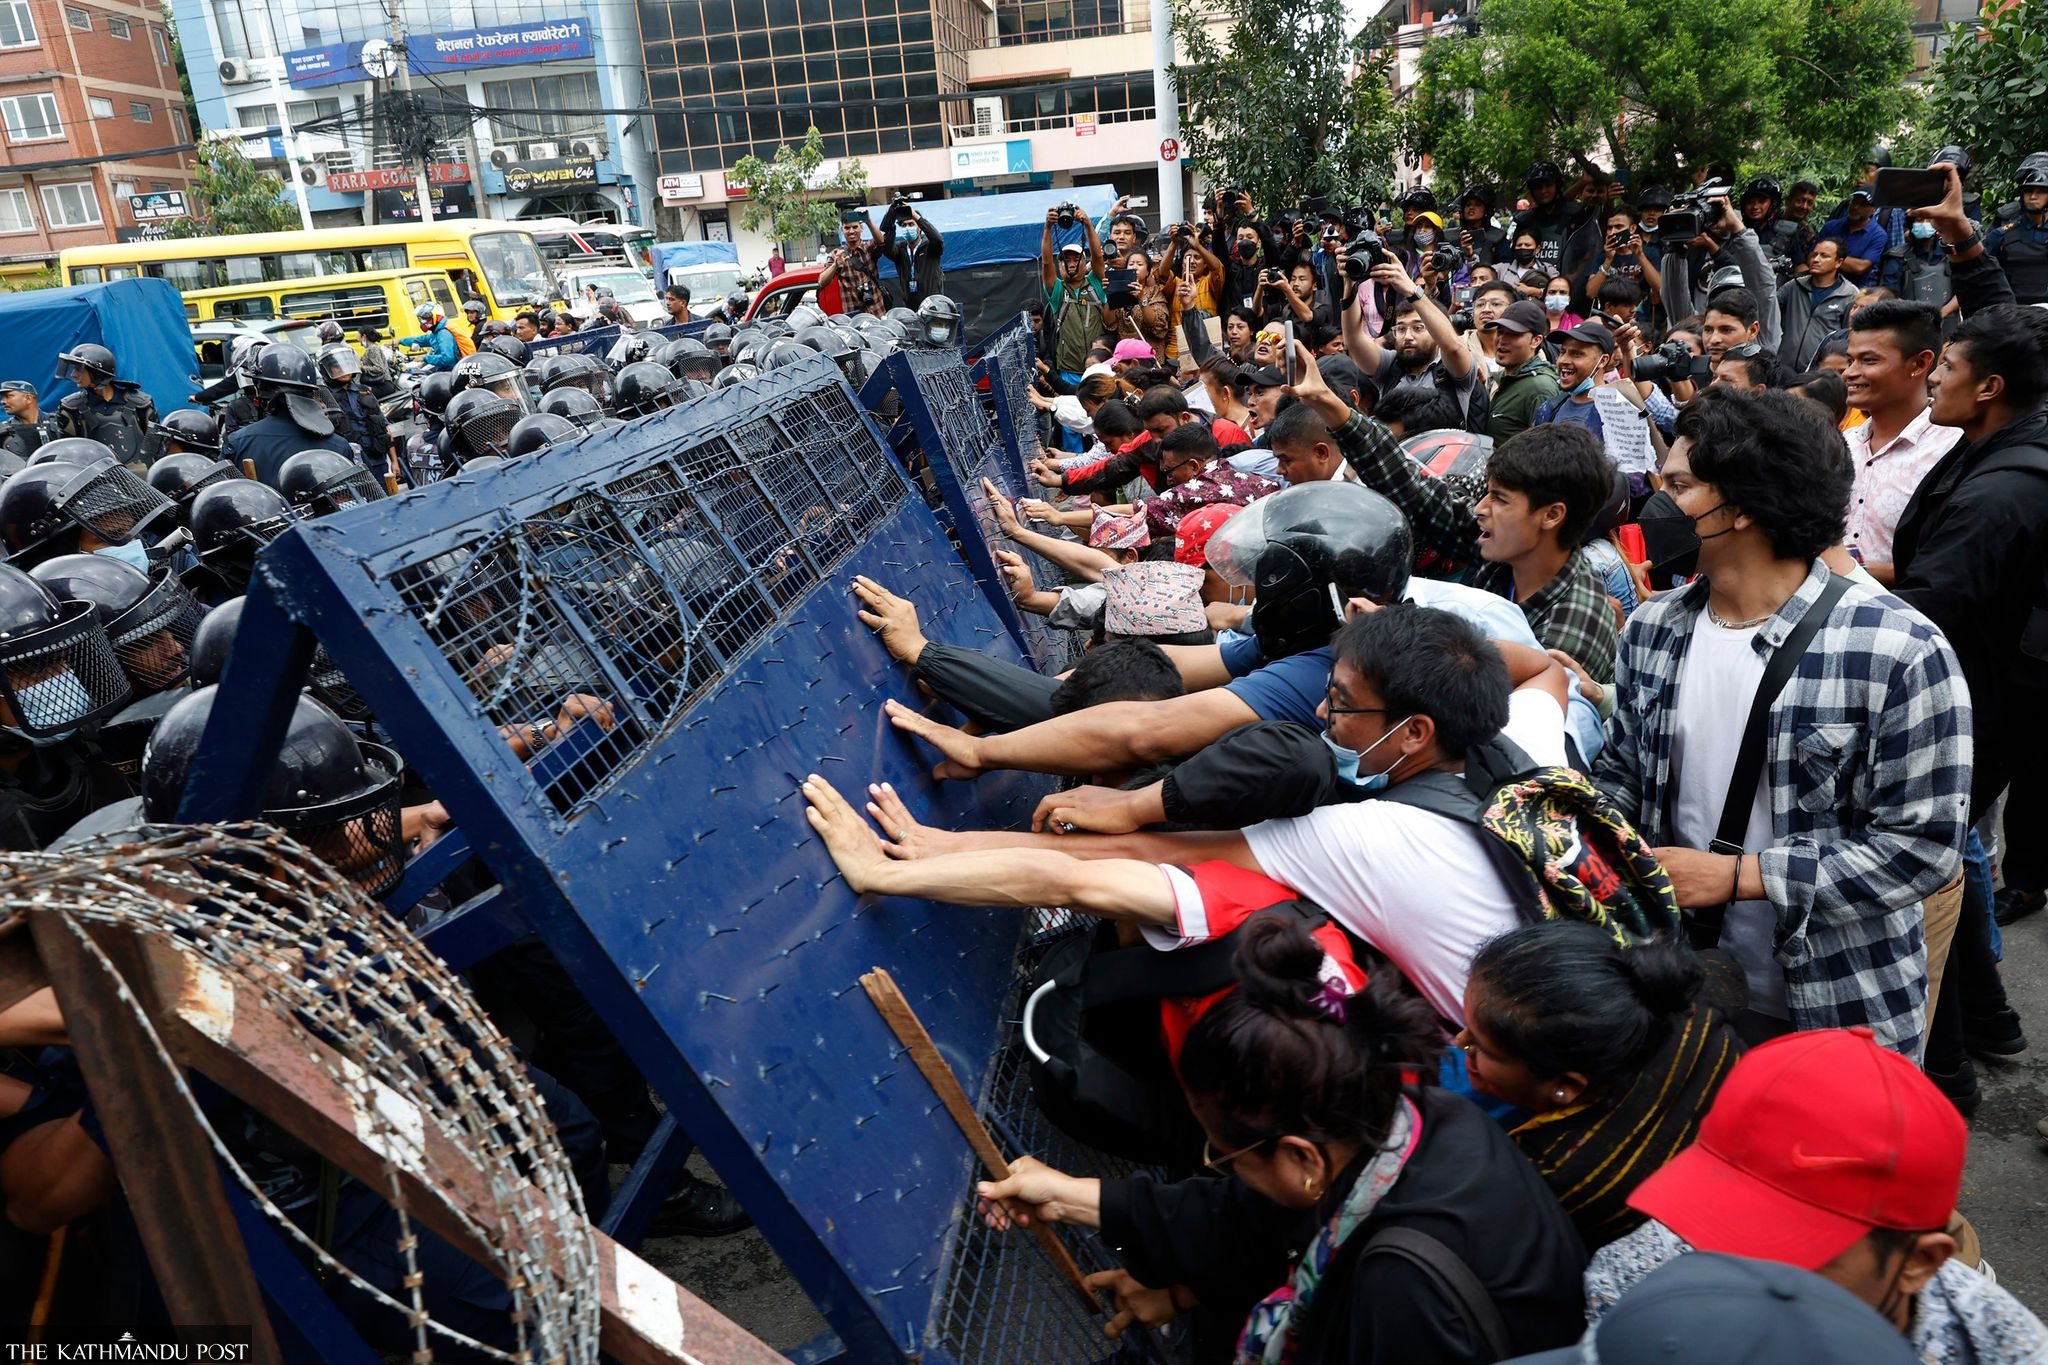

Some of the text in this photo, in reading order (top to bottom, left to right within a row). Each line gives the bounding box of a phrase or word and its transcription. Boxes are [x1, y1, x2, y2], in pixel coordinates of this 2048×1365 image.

[1163, 140, 1174, 150] M
[1163, 149, 1177, 160] 64
[530, 168, 575, 184] MAVEN
[332, 174, 369, 190] RARA
[663, 178, 679, 188] ATM
[458, 368, 481, 376] POLICE
